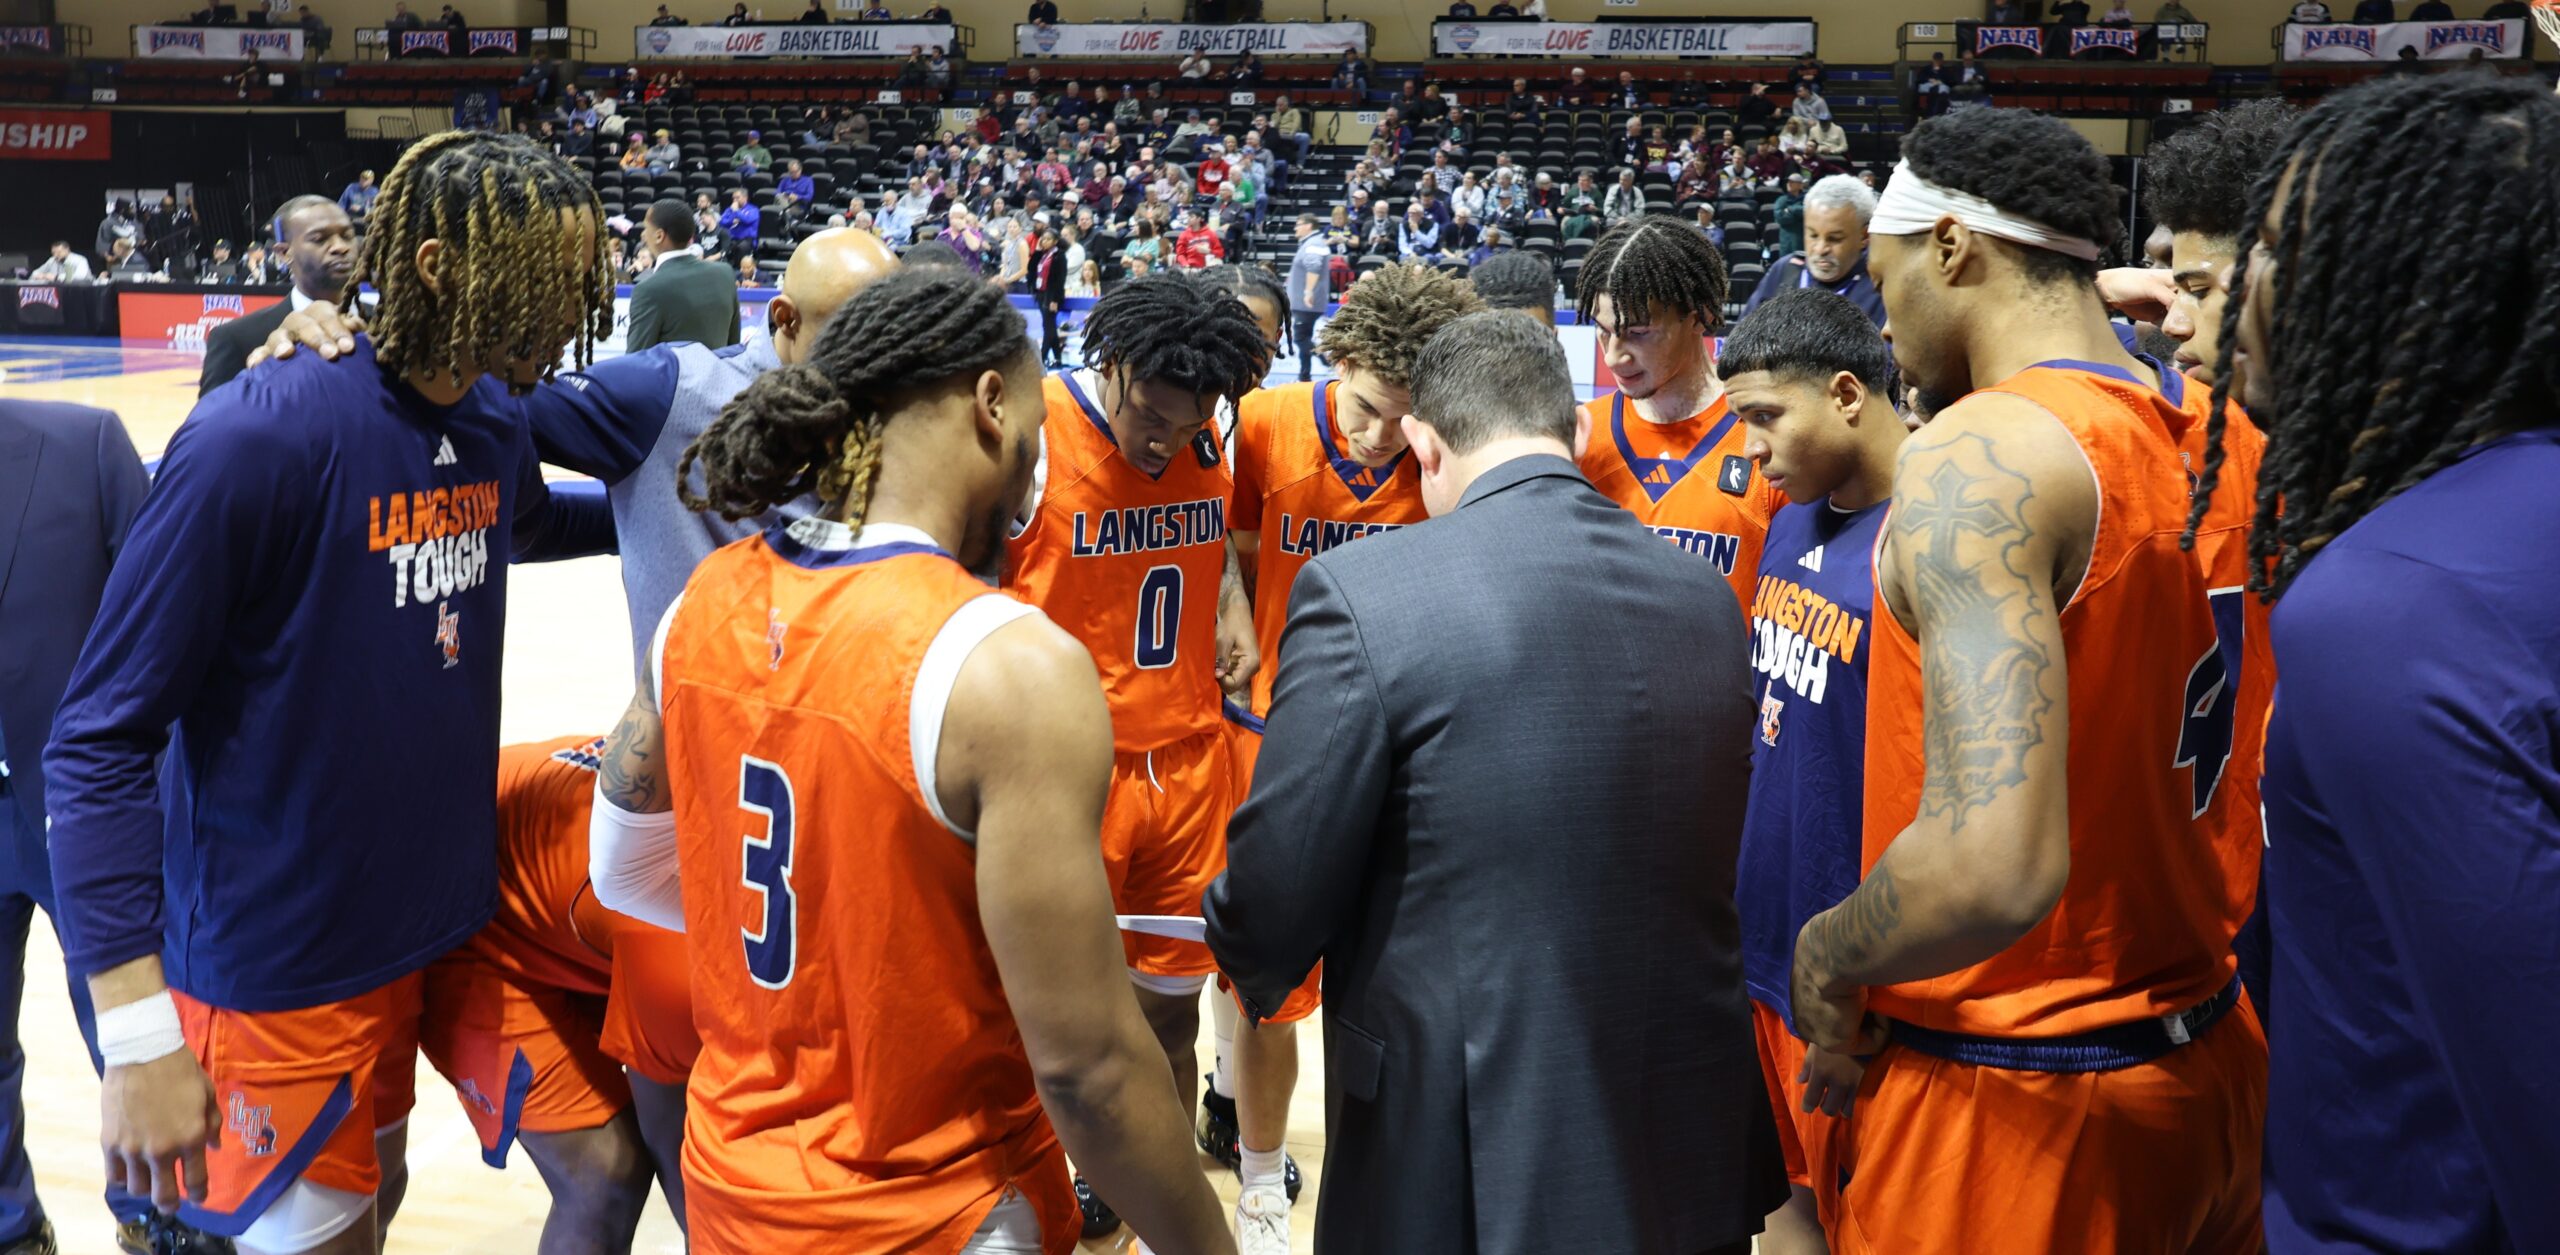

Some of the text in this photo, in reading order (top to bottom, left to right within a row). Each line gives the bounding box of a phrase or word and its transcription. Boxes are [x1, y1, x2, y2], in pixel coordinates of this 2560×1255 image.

[151, 31, 204, 51] NAIA
[241, 32, 290, 52] NAIA
[402, 31, 448, 52] NAIA
[469, 30, 517, 52] NAIA
[725, 31, 767, 52] LOVE
[779, 30, 880, 51] BASKETBALL
[1120, 30, 1163, 51] LOVE
[1177, 29, 1287, 50] BASKETBALL
[1507, 38, 1524, 49] FOR
[1526, 38, 1544, 49] THE
[1545, 29, 1593, 50] LOVE
[1608, 28, 1728, 51] BASKETBALL
[1978, 27, 2042, 53] NAIA
[2072, 27, 2137, 53] NAIA
[2304, 28, 2375, 54] NAIA
[2428, 24, 2503, 53] NAIA
[368, 480, 499, 552] LANGSTON
[1072, 496, 1224, 558] LANGSTON
[389, 528, 488, 608] TOUGH
[1134, 563, 1183, 670] 0
[1750, 574, 1864, 665] ANGSTON
[2173, 585, 2245, 821] 4
[738, 754, 797, 991] 3
